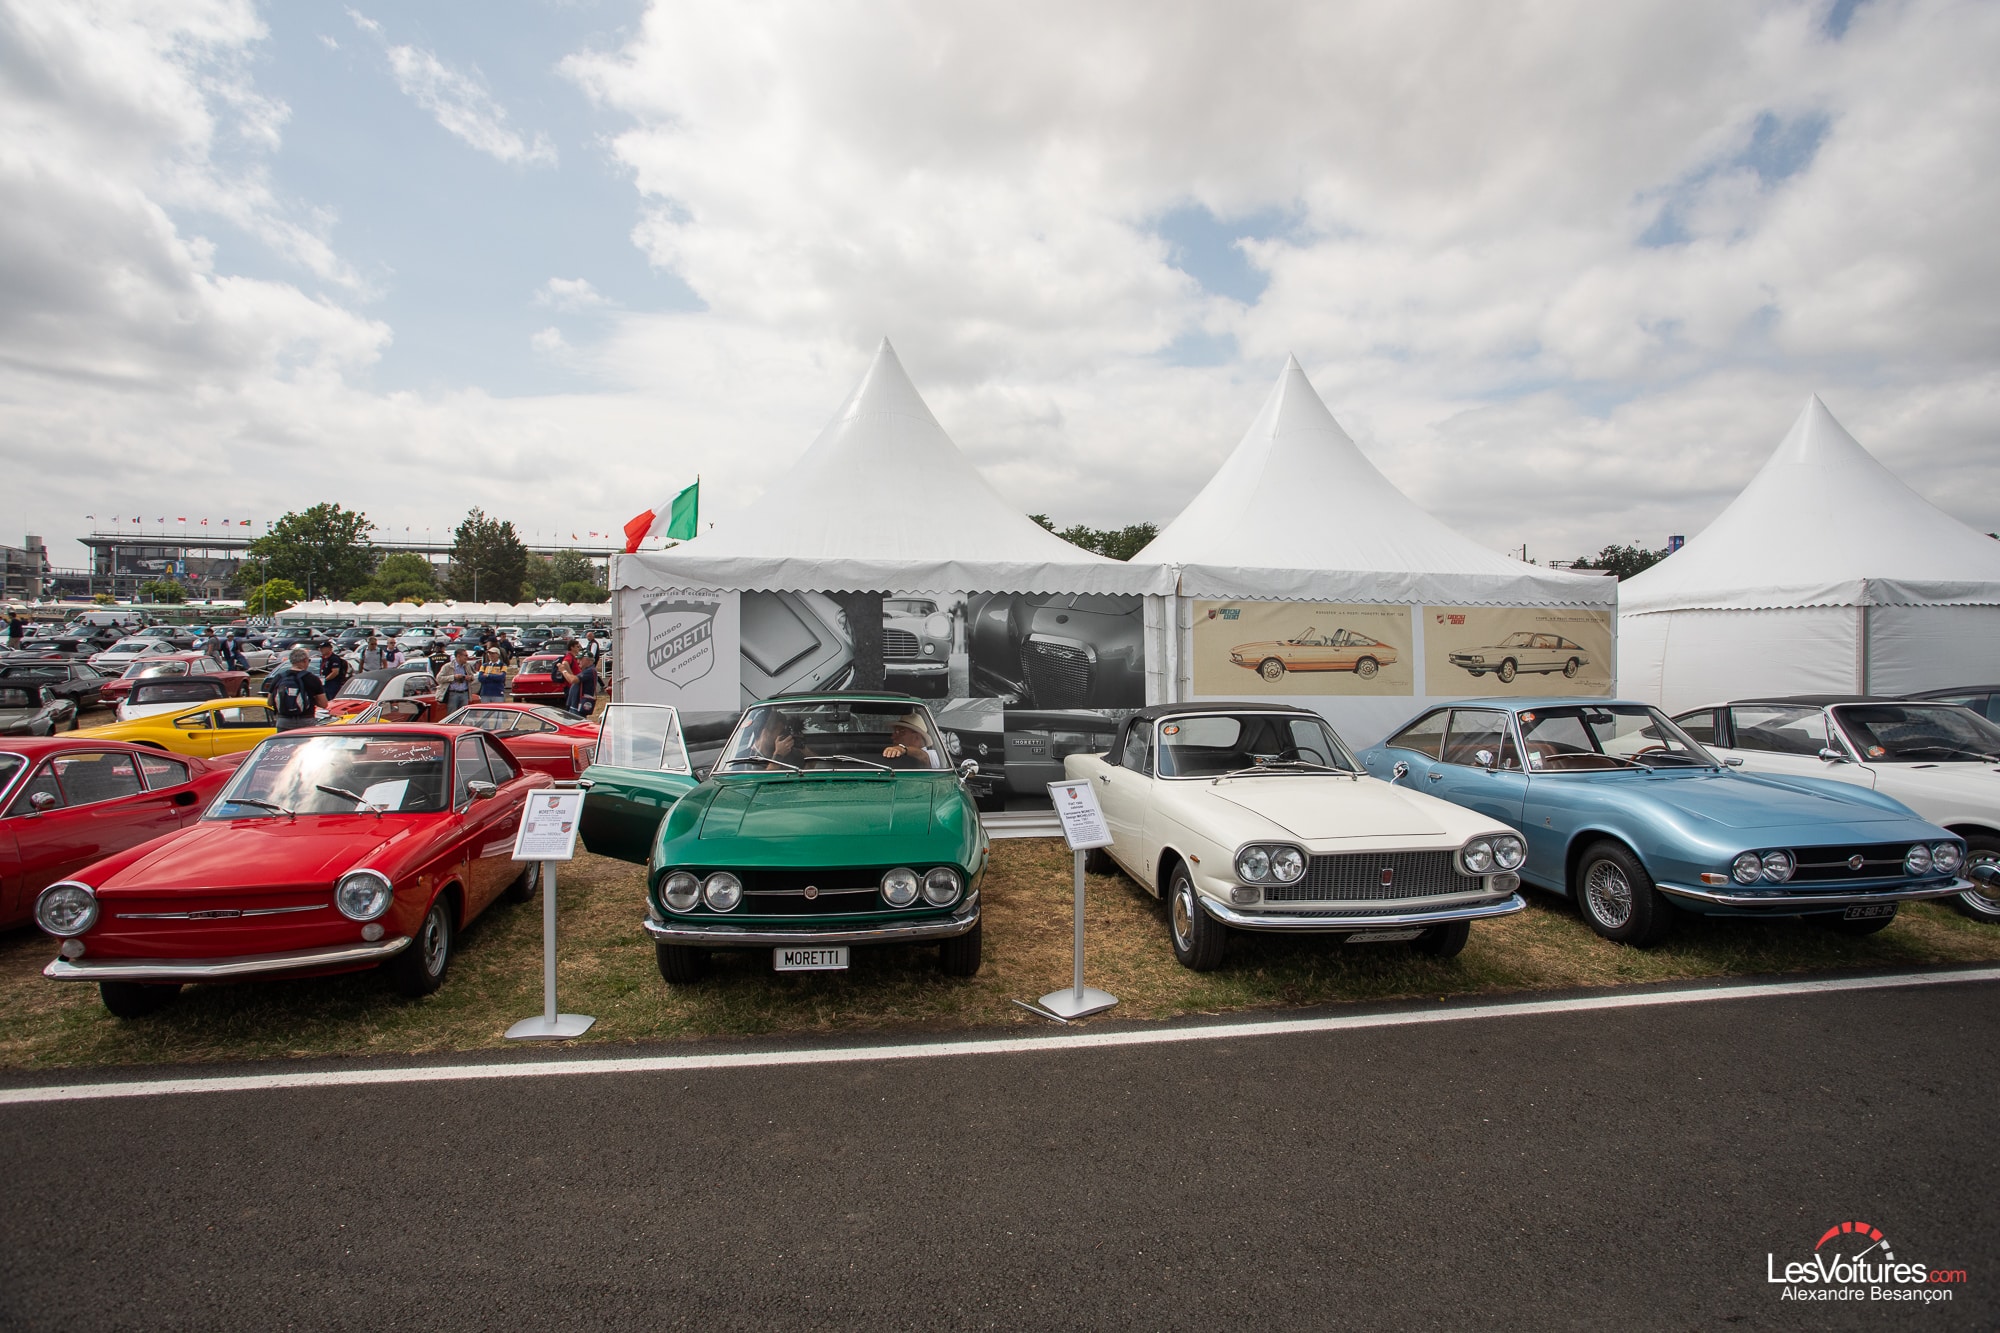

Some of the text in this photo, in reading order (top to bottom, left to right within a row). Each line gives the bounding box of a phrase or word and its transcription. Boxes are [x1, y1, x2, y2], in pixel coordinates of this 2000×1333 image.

[653, 622, 682, 641] museo
[650, 621, 711, 668] MORETTI
[677, 647, 709, 669] nonsolo
[784, 950, 839, 966] MORETTI
